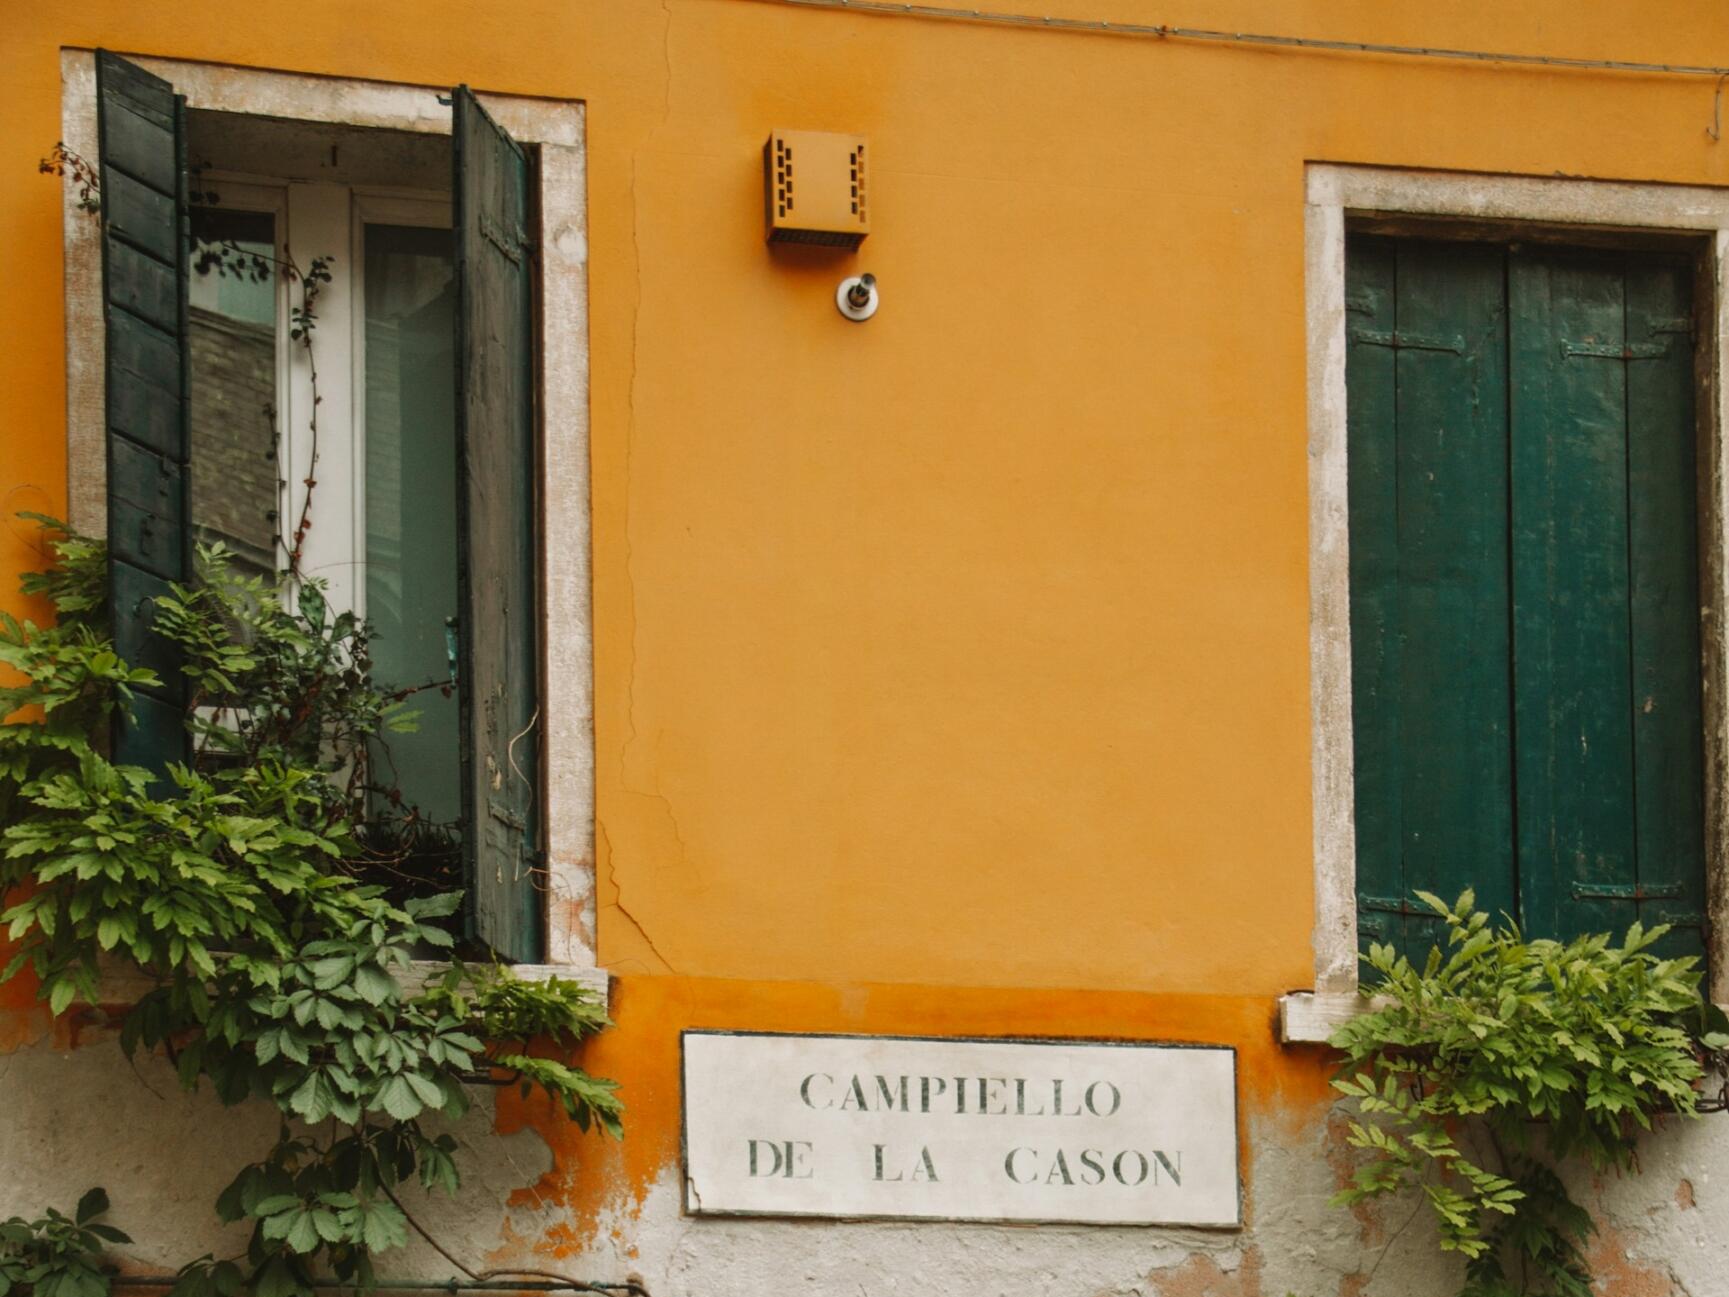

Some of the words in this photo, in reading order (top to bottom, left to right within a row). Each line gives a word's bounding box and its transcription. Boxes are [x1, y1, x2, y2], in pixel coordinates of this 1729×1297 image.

[800, 1072, 1121, 1118] CAMPIELLO
[747, 1139, 814, 1179] DE
[872, 1144, 939, 1183] LA
[1003, 1146, 1182, 1187] CASON
